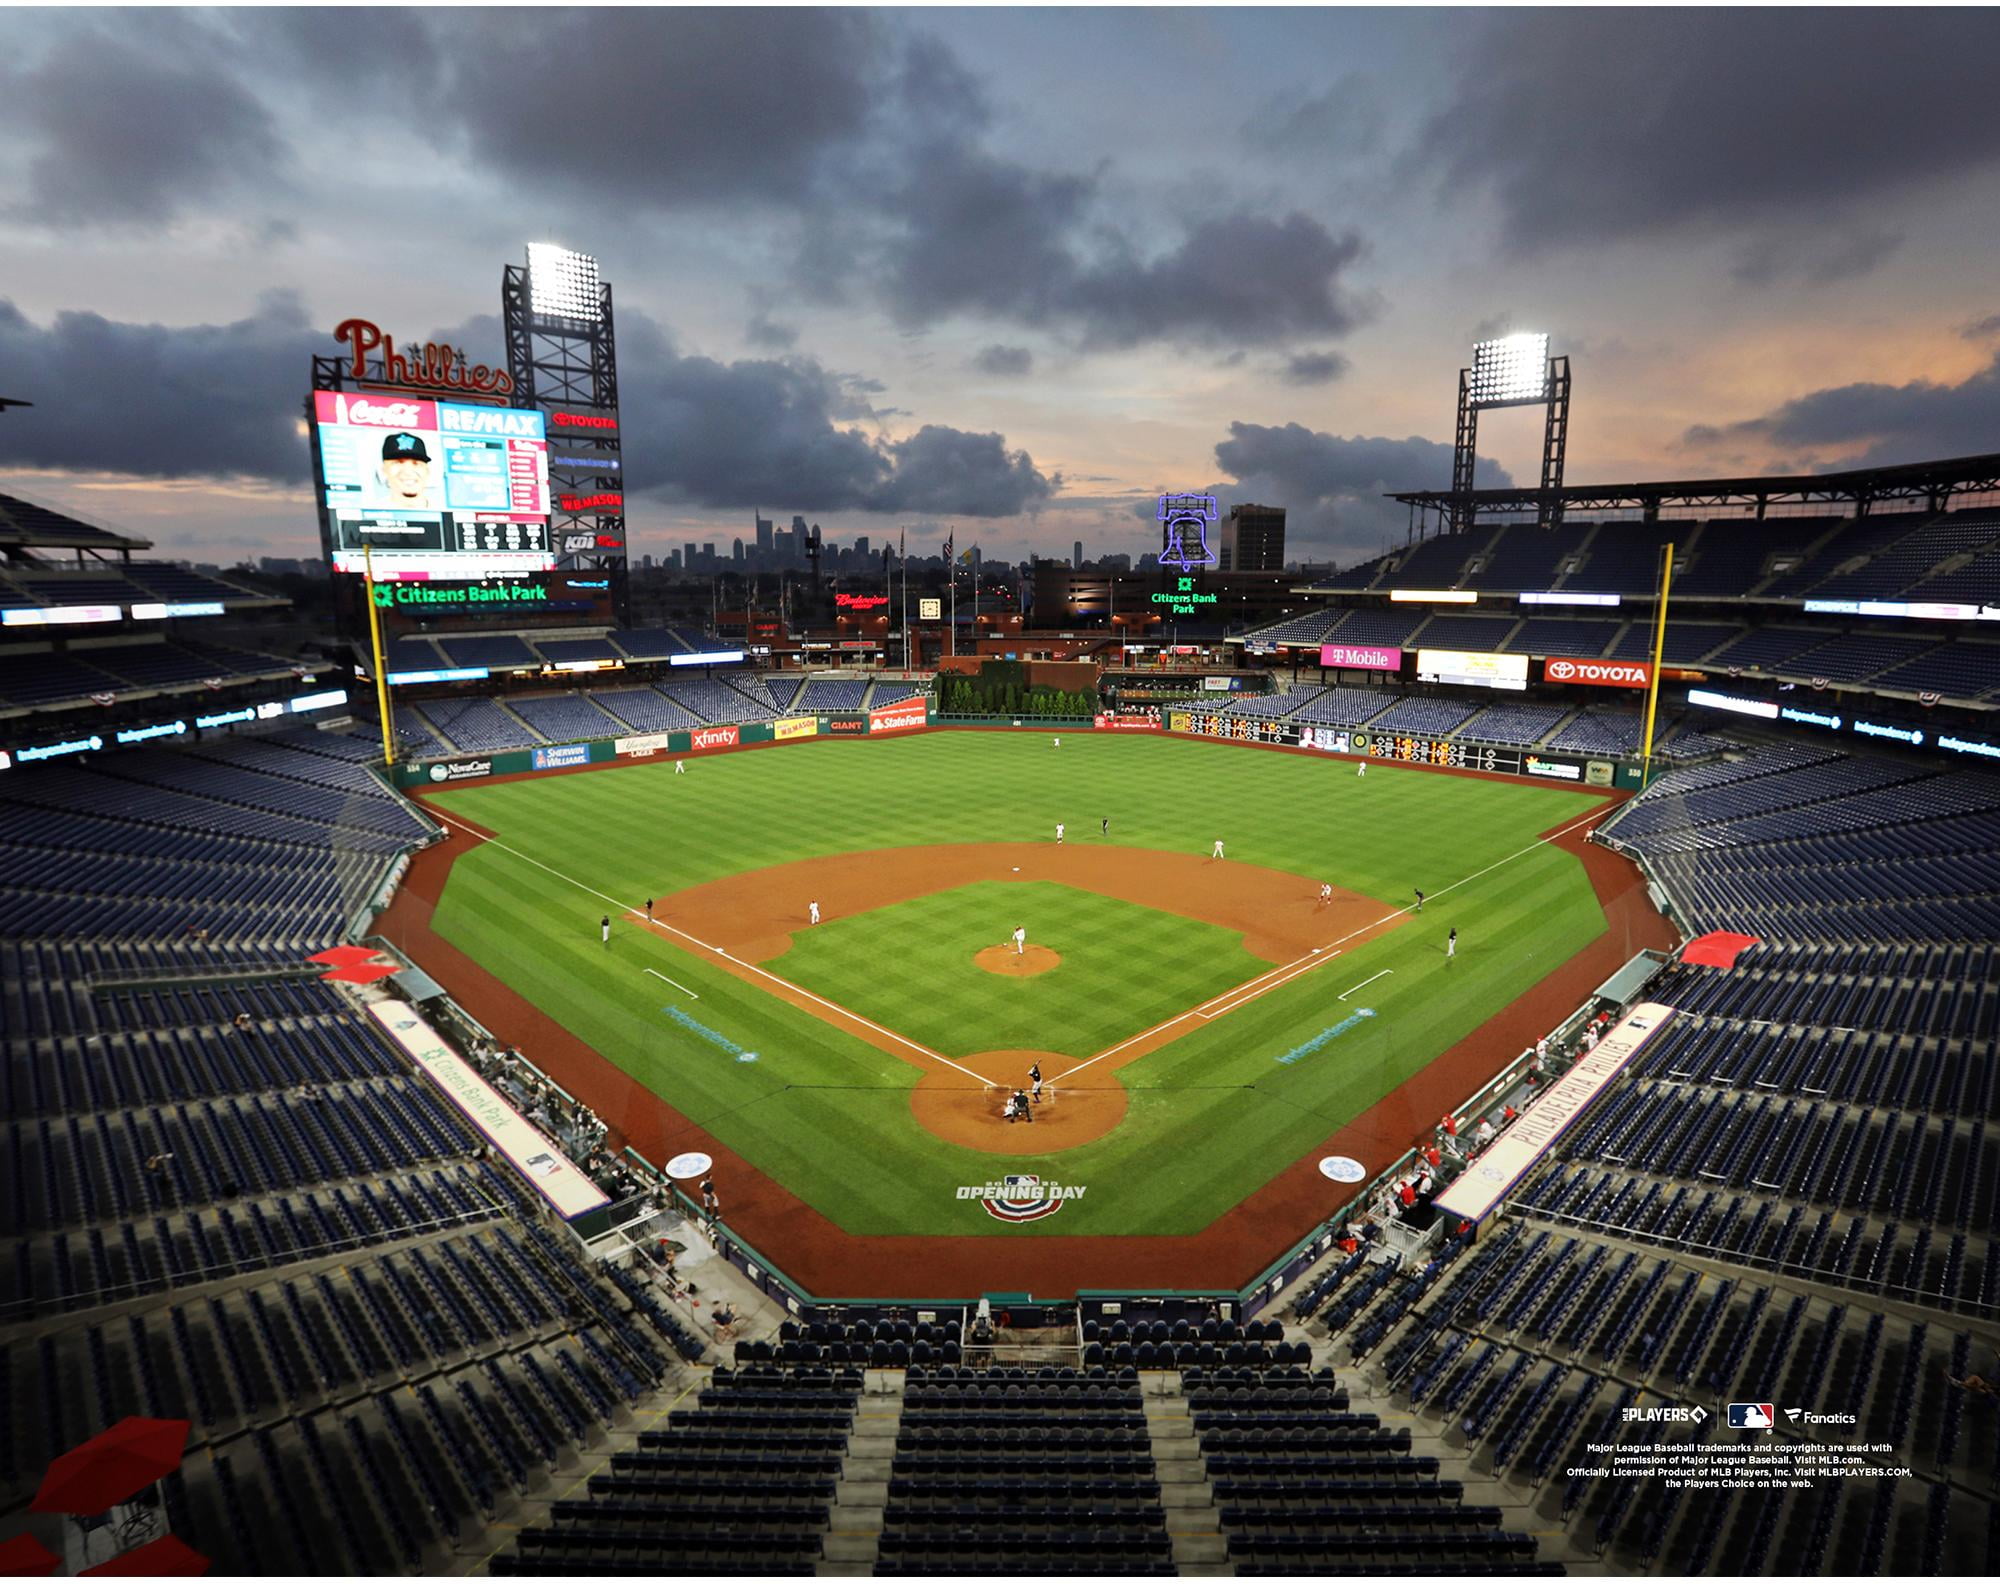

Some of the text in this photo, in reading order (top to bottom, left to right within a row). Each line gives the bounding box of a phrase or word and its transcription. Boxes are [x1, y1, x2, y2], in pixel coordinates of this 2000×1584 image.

[334, 319, 515, 395] Phillies
[442, 409, 538, 435] RE/MAX
[569, 414, 617, 429] TOYOTA
[397, 587, 467, 604] Citizens
[468, 585, 510, 602] Bank
[511, 584, 547, 600] Park
[835, 593, 889, 606] Budweiser
[1151, 593, 1217, 603] Citizens Bank
[1172, 604, 1195, 613] Park
[1333, 649, 1388, 666] T Mobile
[1577, 665, 1647, 682] TOYOTA
[694, 729, 736, 748] xfinity
[547, 746, 585, 758] SHERWIN
[448, 761, 491, 774] NovaCare
[434, 1059, 512, 1129] Citizens Bank Park
[1511, 1039, 1632, 1147] PHILADELPHIA PHILLIES
[956, 1186, 1087, 1199] OPENING DAY
